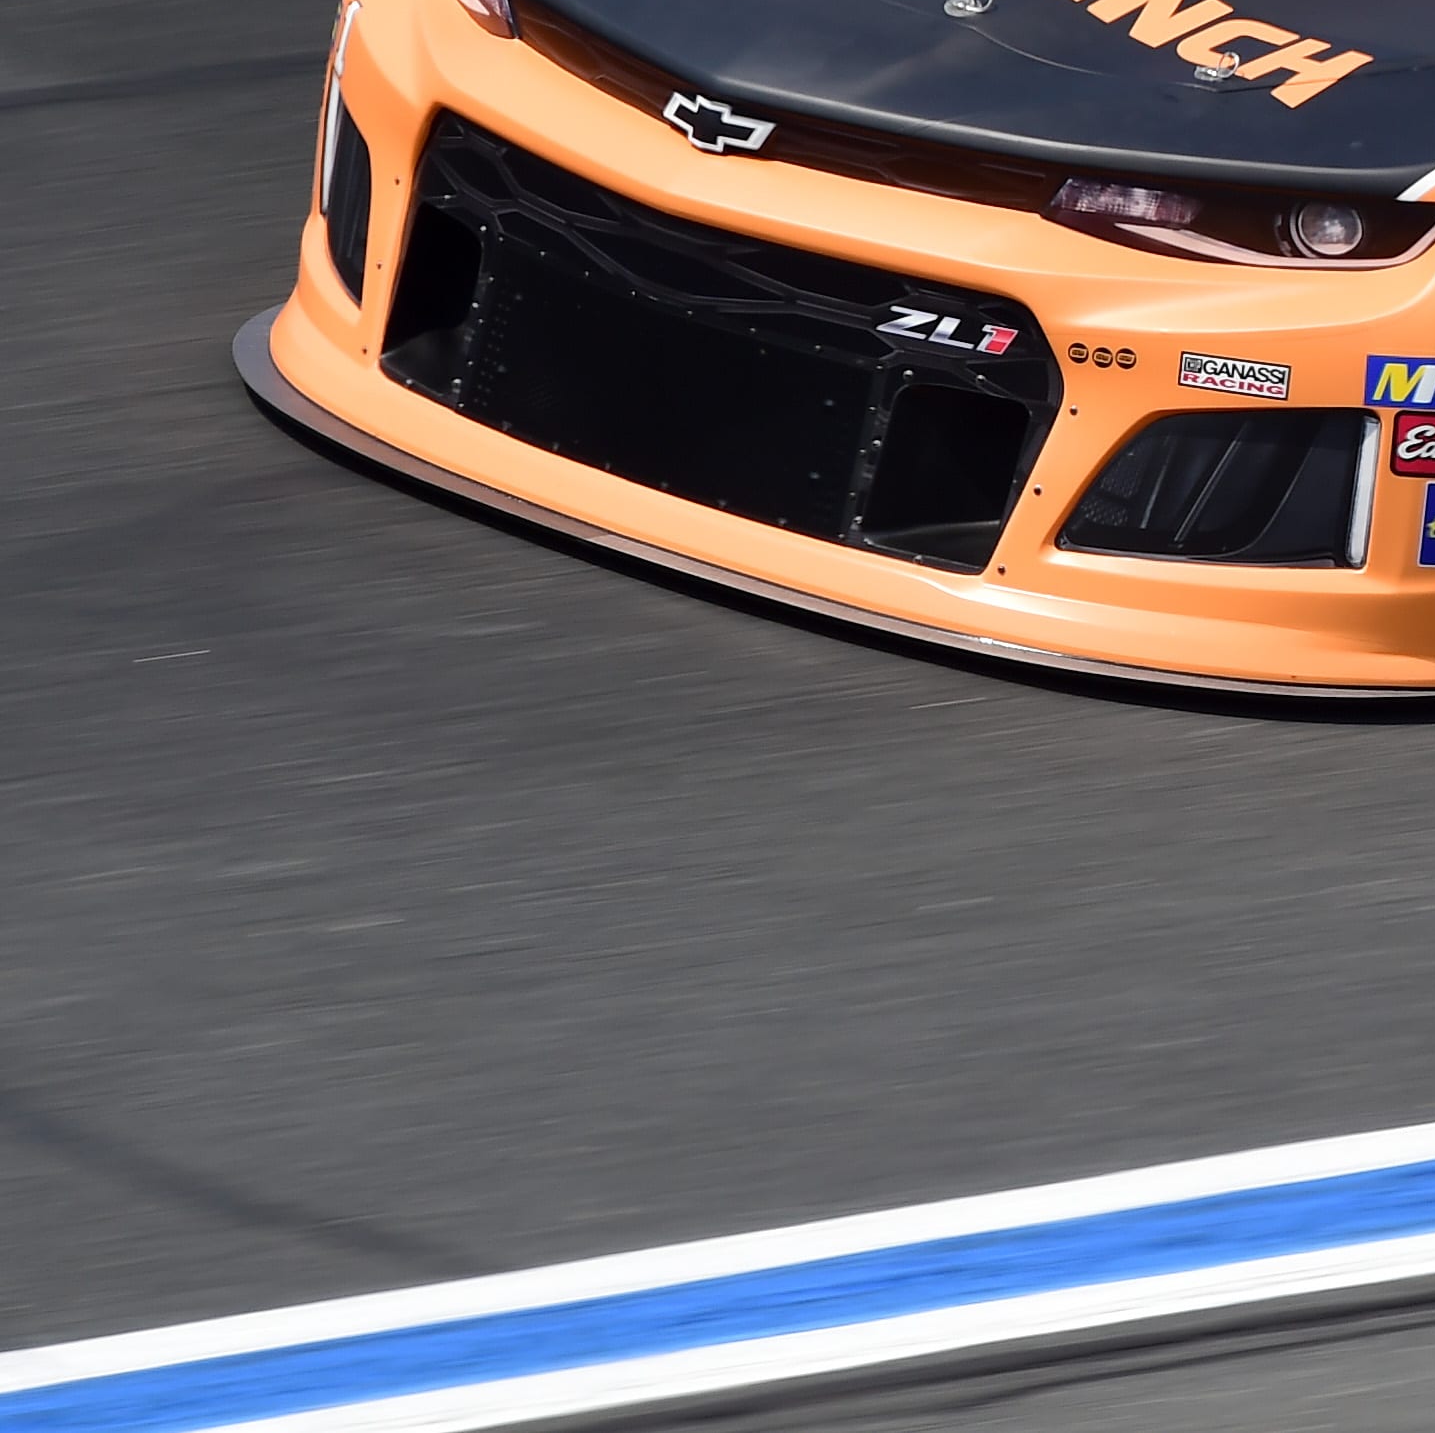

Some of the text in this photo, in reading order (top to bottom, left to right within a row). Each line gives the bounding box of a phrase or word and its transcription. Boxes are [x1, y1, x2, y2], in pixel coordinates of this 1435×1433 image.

[876, 305, 1019, 355] ZL1
[1182, 372, 1285, 395] RACING
[1203, 360, 1286, 385] GANASSI
